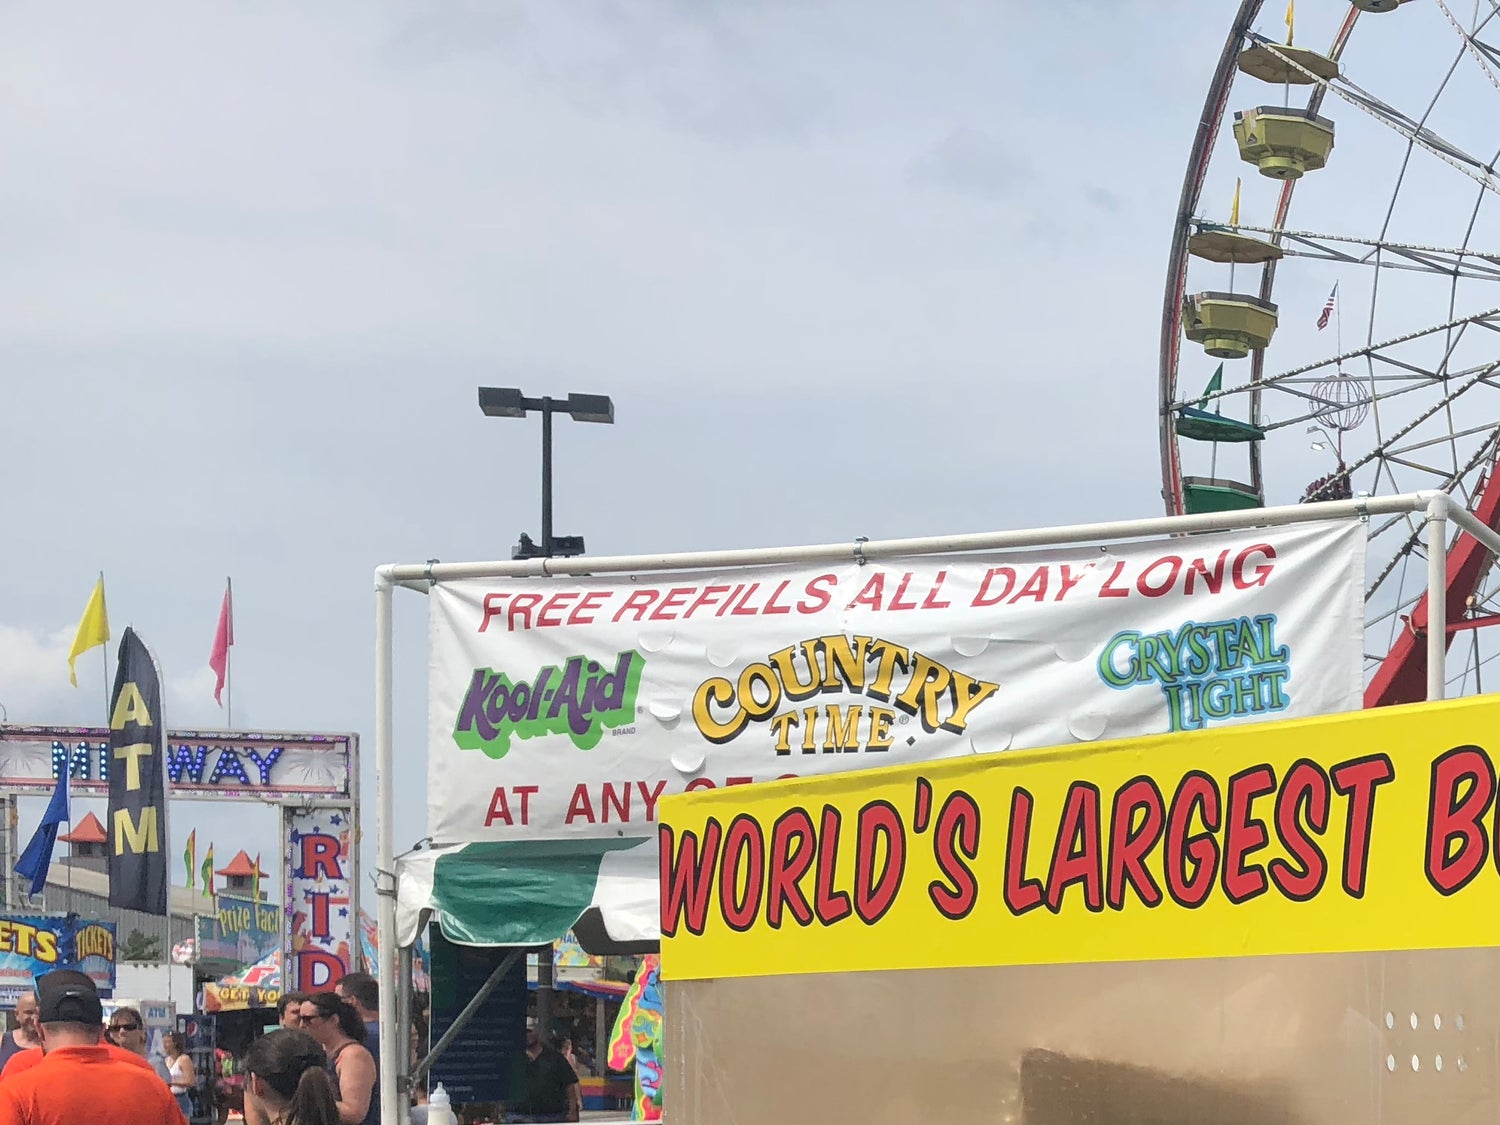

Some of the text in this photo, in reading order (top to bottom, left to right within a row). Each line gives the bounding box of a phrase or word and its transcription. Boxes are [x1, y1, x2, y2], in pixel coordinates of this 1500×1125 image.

[478, 543, 1277, 633] FREE REFILLS ALL DAY LONG
[1098, 616, 1286, 689] CRYSTAL
[455, 651, 634, 742] Kool-Aid
[692, 634, 999, 744] COUNTRY
[1162, 670, 1289, 732] LIGHT
[612, 726, 636, 736] BRAND
[772, 704, 896, 756] TIME
[51, 741, 285, 786] MIWAY
[110, 681, 159, 856] ATM
[485, 780, 667, 827] AT ANY
[660, 776, 979, 936] WORLD'S
[1004, 752, 1393, 913] LARGEST
[76, 924, 114, 961] TICKETS
[219, 987, 249, 1000] GET
